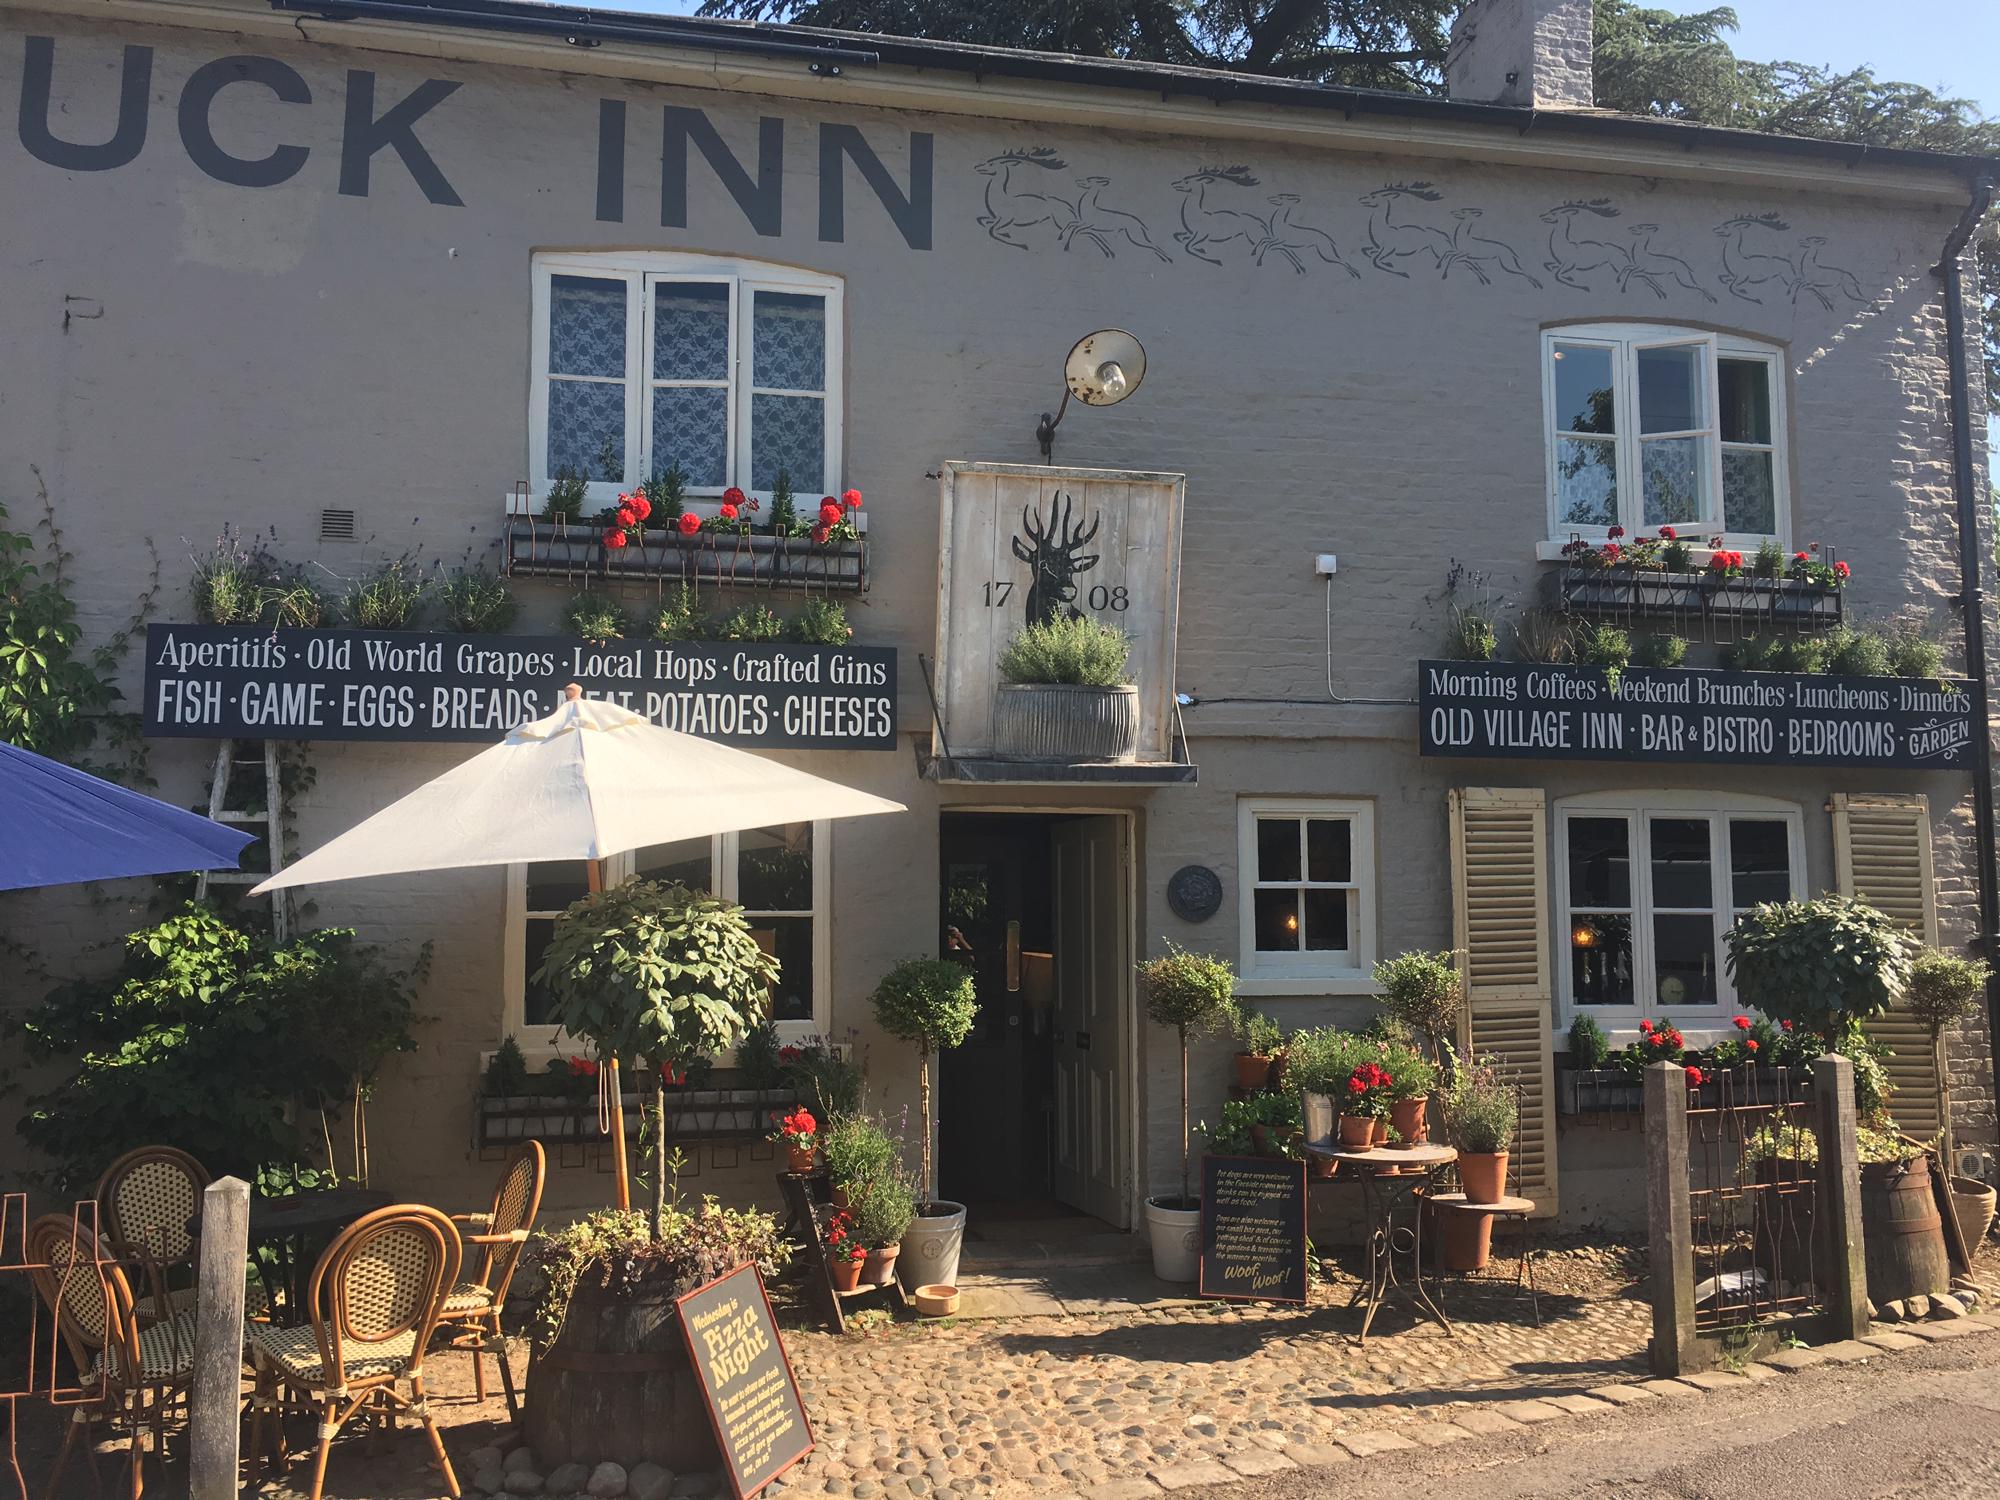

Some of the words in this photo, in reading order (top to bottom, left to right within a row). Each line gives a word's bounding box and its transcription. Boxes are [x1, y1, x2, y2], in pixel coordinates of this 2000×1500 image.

[18, 35, 466, 208] UCK
[595, 98, 935, 251] INN
[982, 581, 1014, 607] 17
[1089, 585, 1130, 612] 08
[156, 633, 286, 672] Aperitifs
[307, 638, 351, 671] Old
[364, 640, 443, 673] World
[457, 643, 554, 682] Grapes
[573, 647, 642, 679] Local
[654, 650, 717, 687] Hops
[733, 652, 820, 685] Crafted
[830, 654, 887, 687] Gins
[157, 679, 222, 724] FISH
[241, 682, 325, 727] GAME
[342, 685, 414, 728] EGGS
[432, 687, 538, 730] BREADS
[646, 691, 768, 736] POTATOES
[784, 695, 891, 738] CHEESES
[1429, 668, 1517, 700] Morning
[1526, 671, 1597, 701] Coffees
[1607, 675, 1691, 704] Weekend
[1697, 677, 1785, 707] Brunches
[1795, 681, 1889, 711] Luncheons
[1900, 685, 1971, 713] Dinners
[1431, 707, 1474, 746] OLD
[1484, 709, 1571, 748] VILLAGE
[1582, 712, 1623, 750] INN
[1642, 714, 1684, 751] BAR
[1688, 725, 1698, 742] &
[1703, 715, 1774, 754] BISTRO
[1789, 718, 1895, 757] BEDROOMS
[1909, 720, 1969, 756] GARDEN
[692, 1303, 732, 1332] Wednesday
[730, 1297, 738, 1310] is
[702, 1305, 758, 1359] Pizza
[709, 1325, 769, 1389] Night
